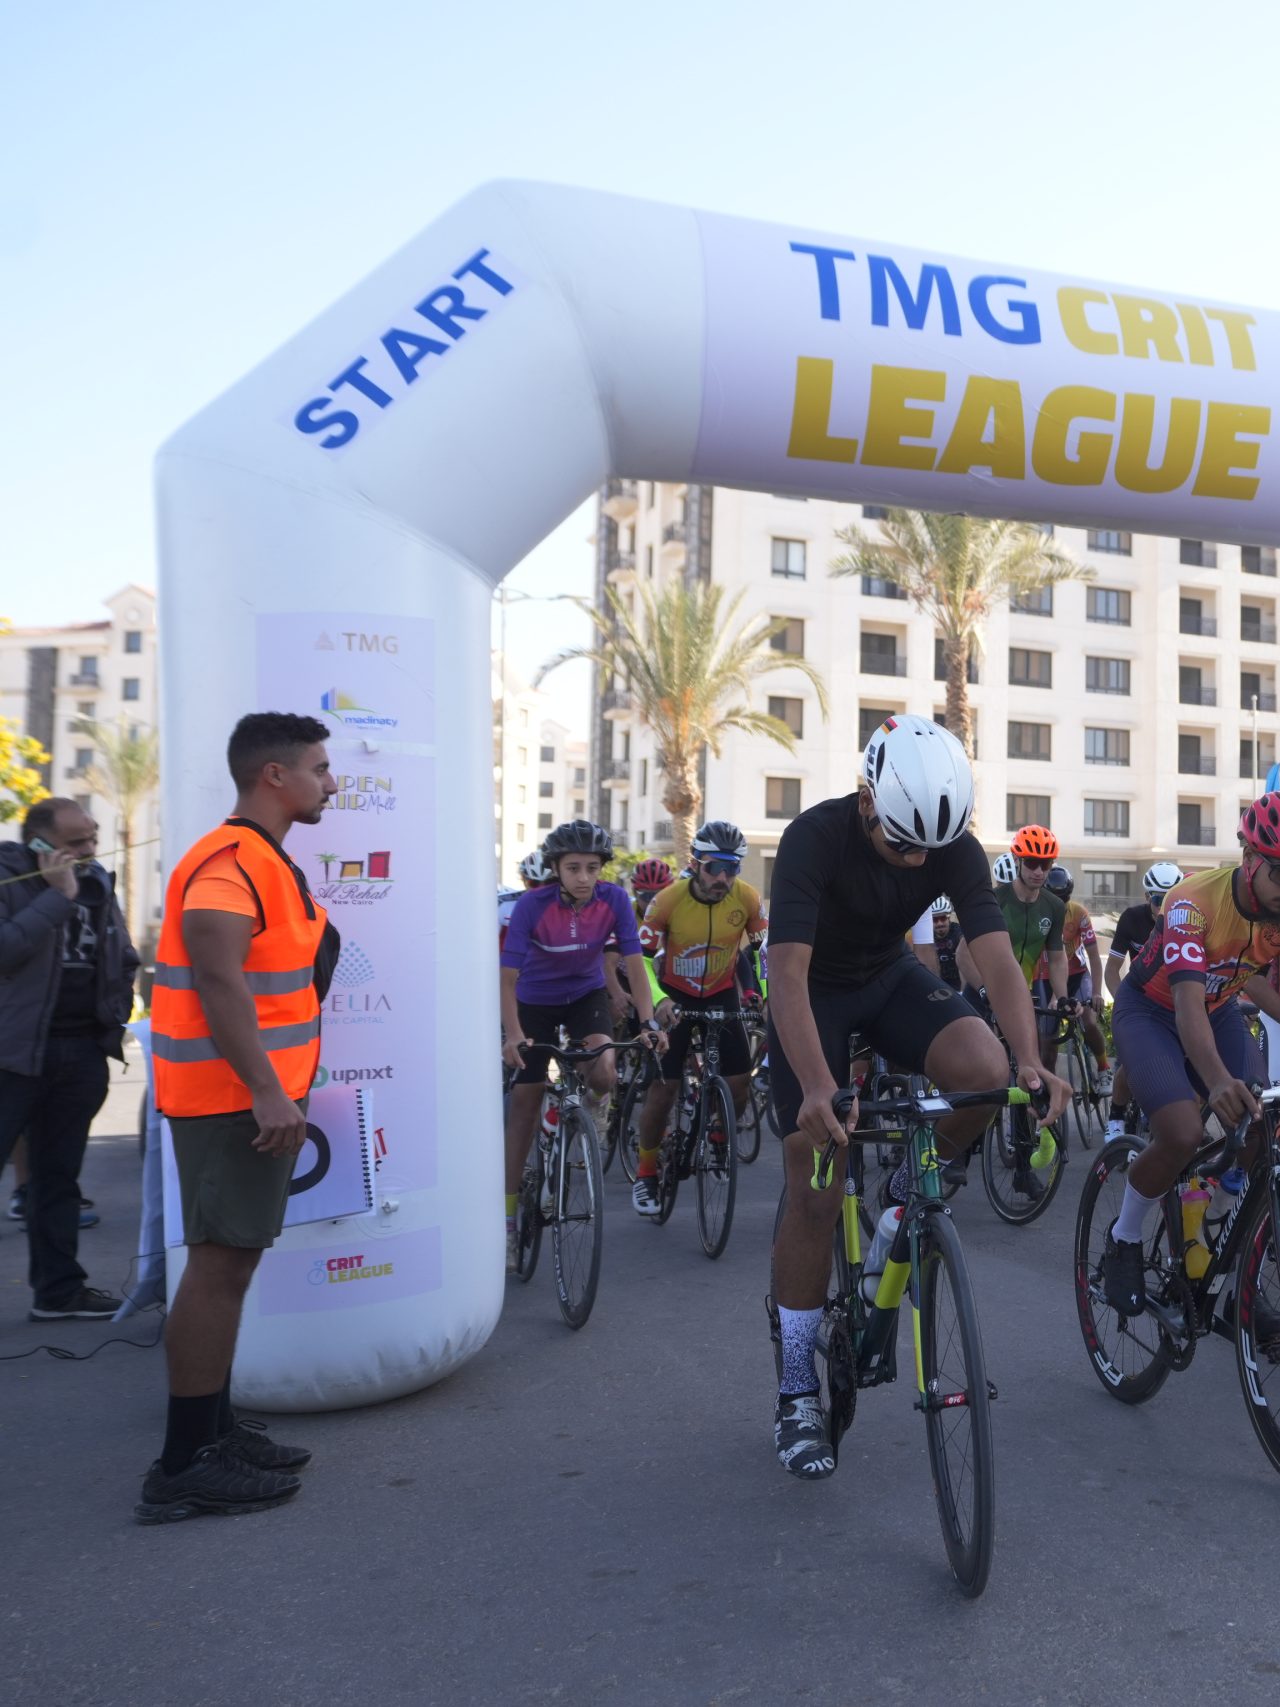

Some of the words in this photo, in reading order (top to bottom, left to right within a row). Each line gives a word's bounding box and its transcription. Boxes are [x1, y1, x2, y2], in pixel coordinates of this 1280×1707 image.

[789, 240, 1042, 346] TMG
[1055, 285, 1258, 373] CRIT
[293, 247, 515, 450] START
[786, 355, 1271, 502] LEAGUE
[342, 632, 399, 654] TMG
[345, 716, 398, 728] madinaty
[333, 775, 392, 792] PEN
[338, 884, 392, 900] Rehab
[1163, 942, 1205, 965] CC
[322, 994, 392, 1012] ELIA
[322, 1017, 340, 1025] EW
[332, 1065, 394, 1085] upnxt
[326, 1254, 364, 1272] CRIT
[328, 1263, 394, 1284] LEAGUE
